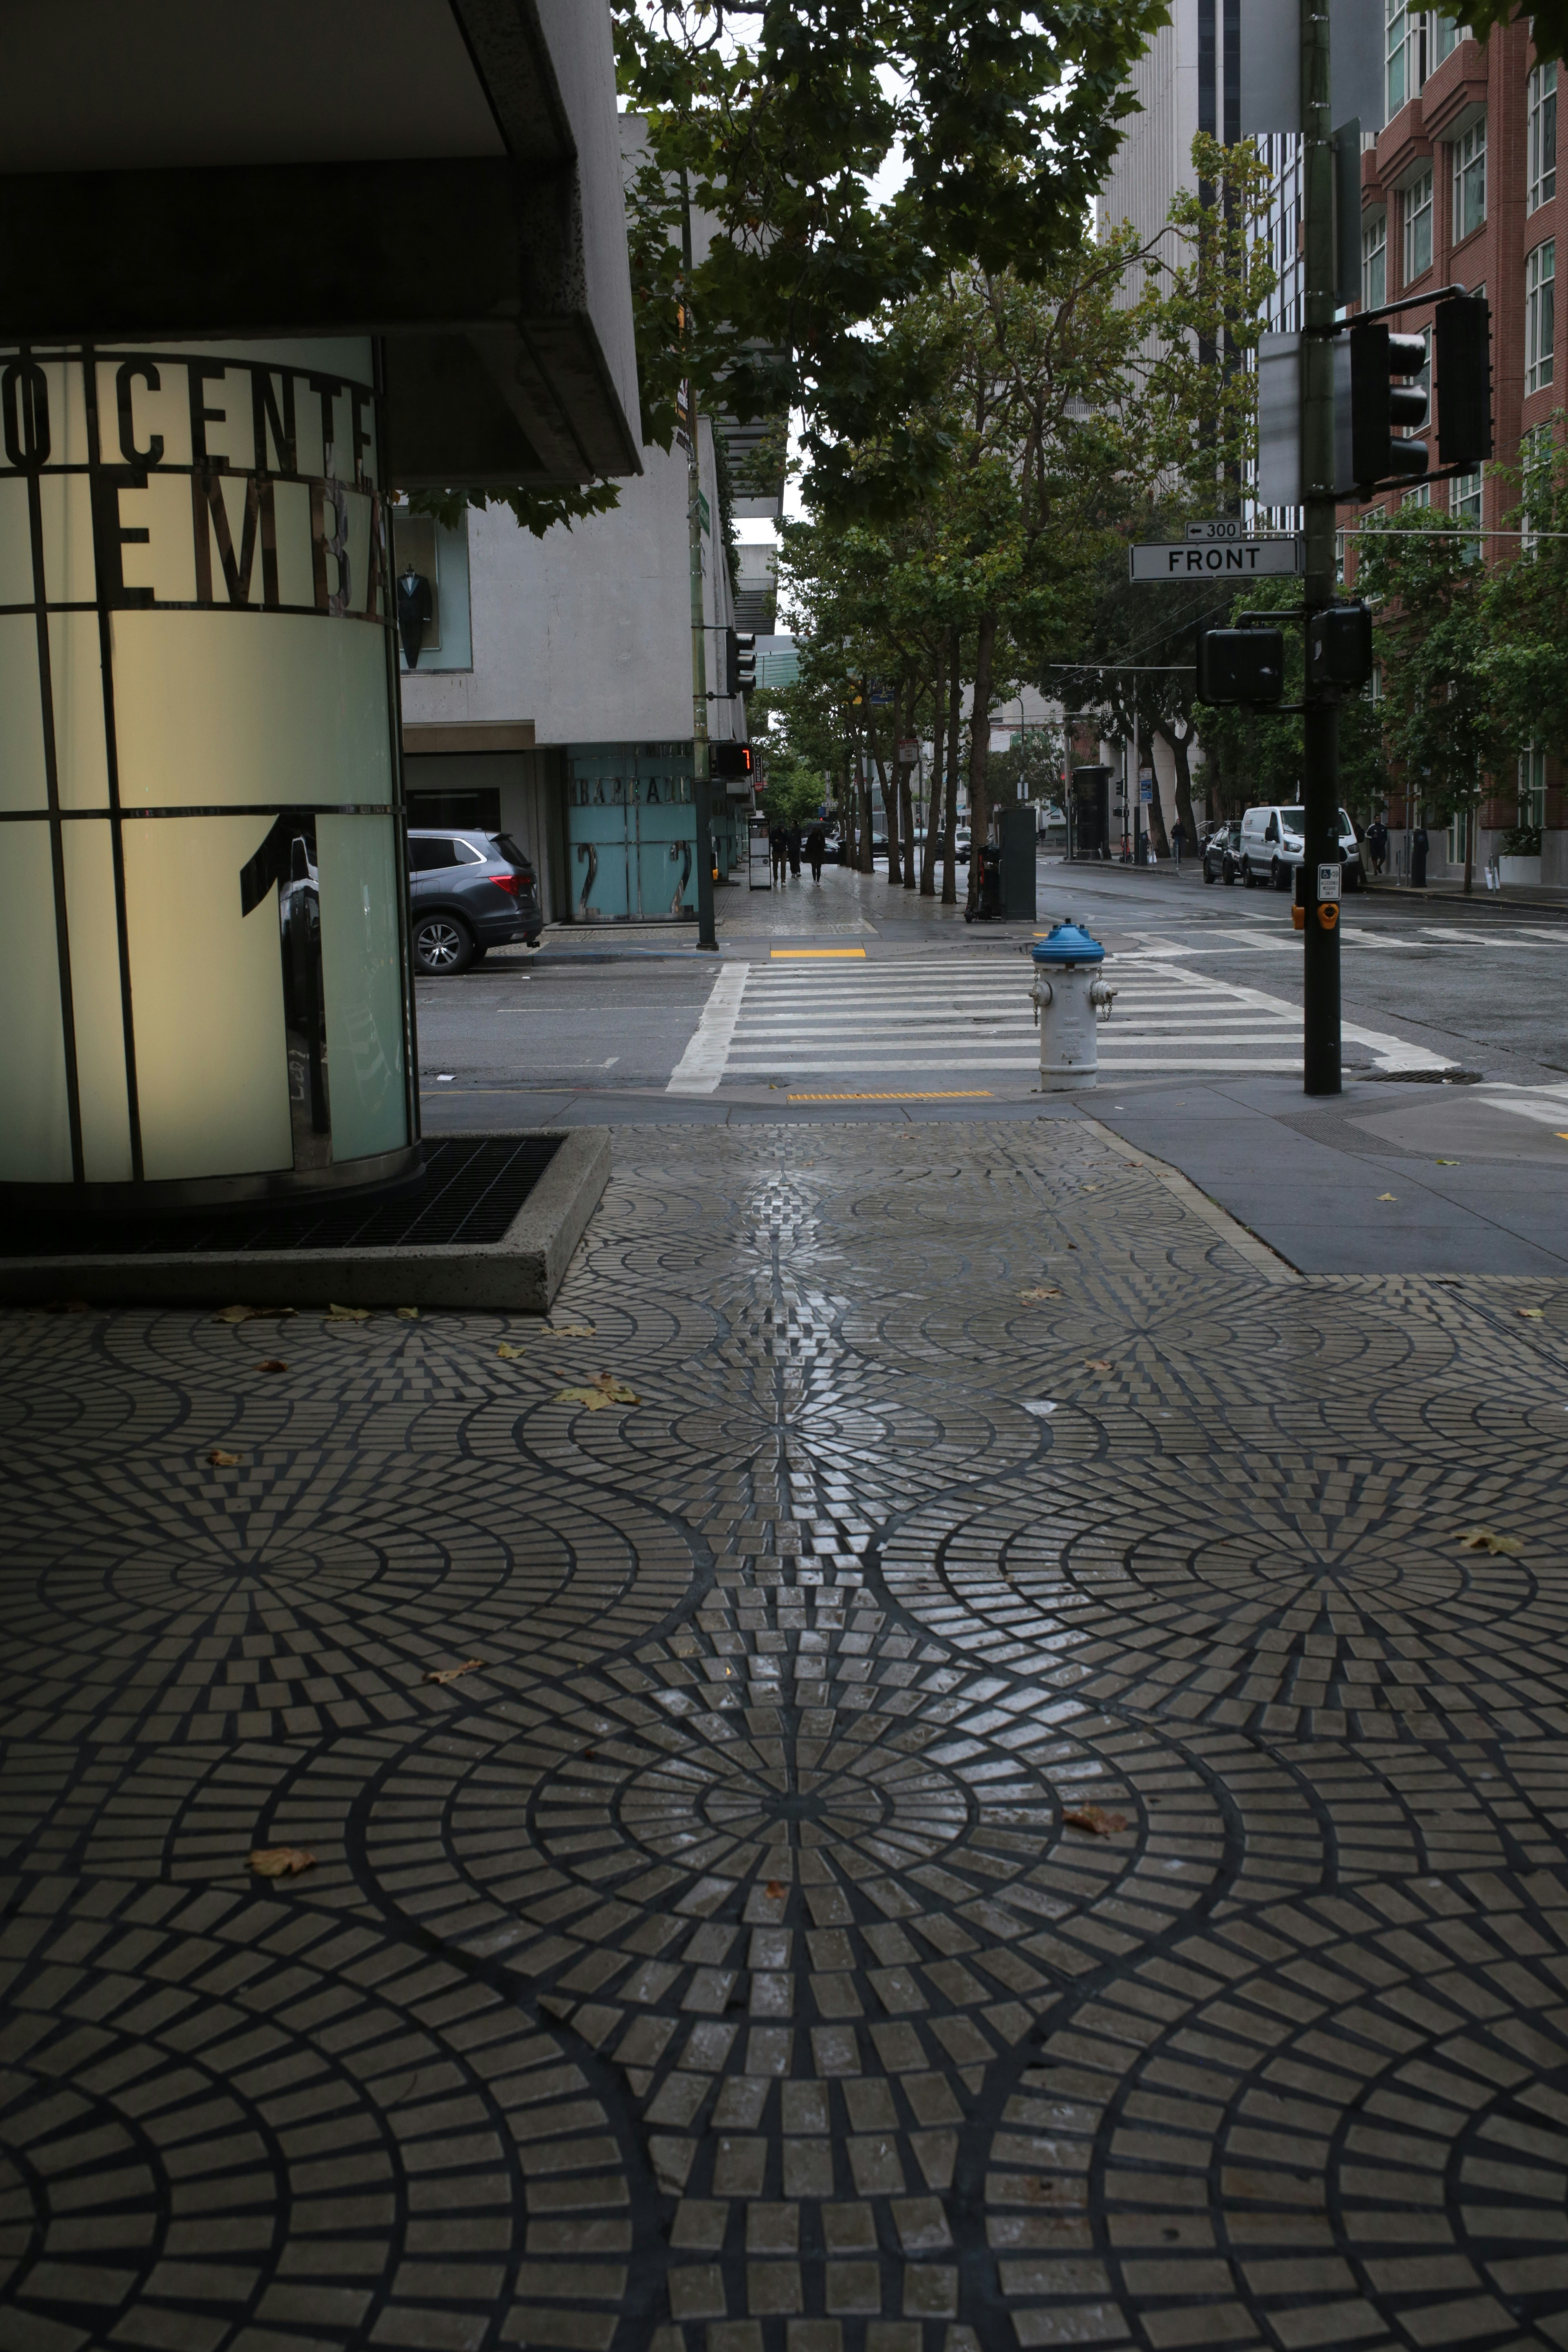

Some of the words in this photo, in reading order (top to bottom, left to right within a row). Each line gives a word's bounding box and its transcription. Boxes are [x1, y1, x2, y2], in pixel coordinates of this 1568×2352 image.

[1169, 548, 1260, 571] FRONT
[1207, 523, 1236, 537] 300
[578, 844, 599, 915] 2
[670, 841, 694, 913] 2
[240, 814, 333, 1169] 1
